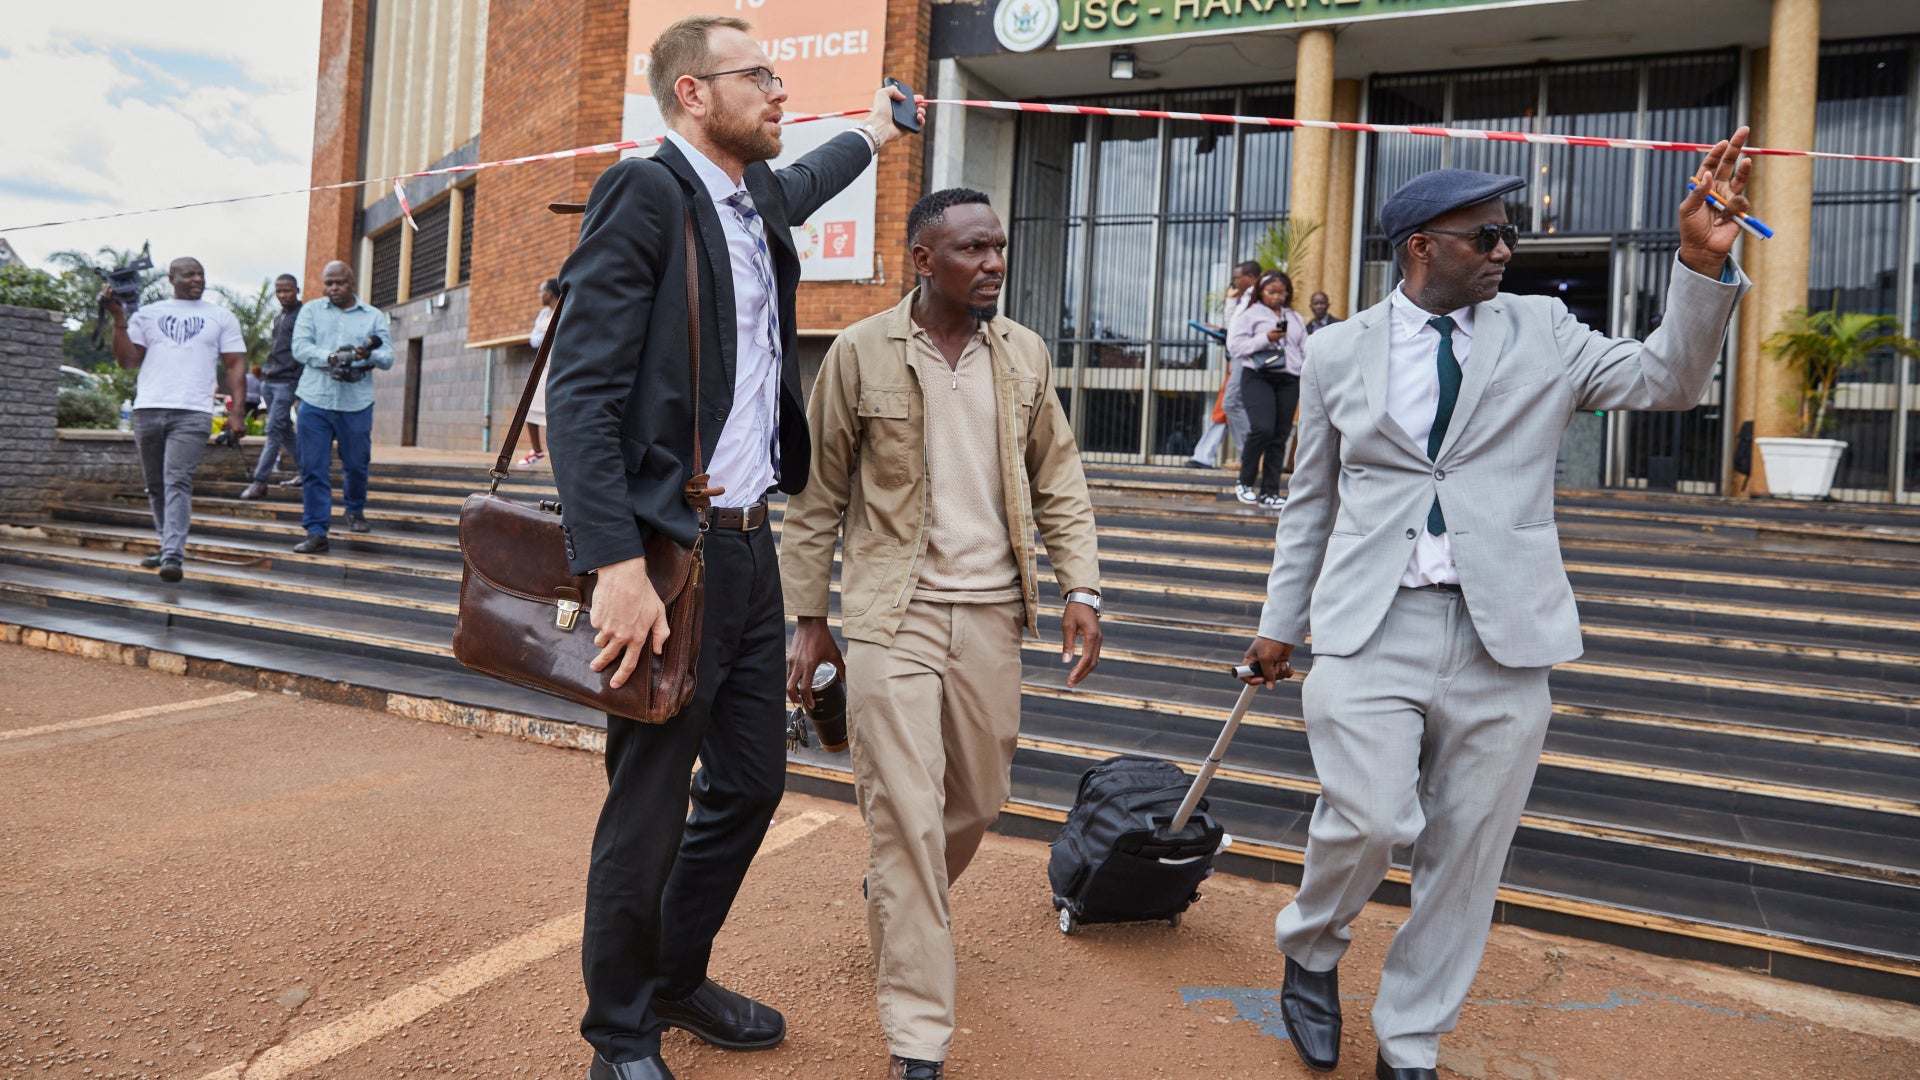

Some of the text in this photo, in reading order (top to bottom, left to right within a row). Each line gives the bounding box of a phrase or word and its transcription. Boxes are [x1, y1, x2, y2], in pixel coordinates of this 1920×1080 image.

[1062, 0, 1138, 31] JSC
[1148, 7, 1162, 15] -
[759, 29, 868, 62] USTICE!
